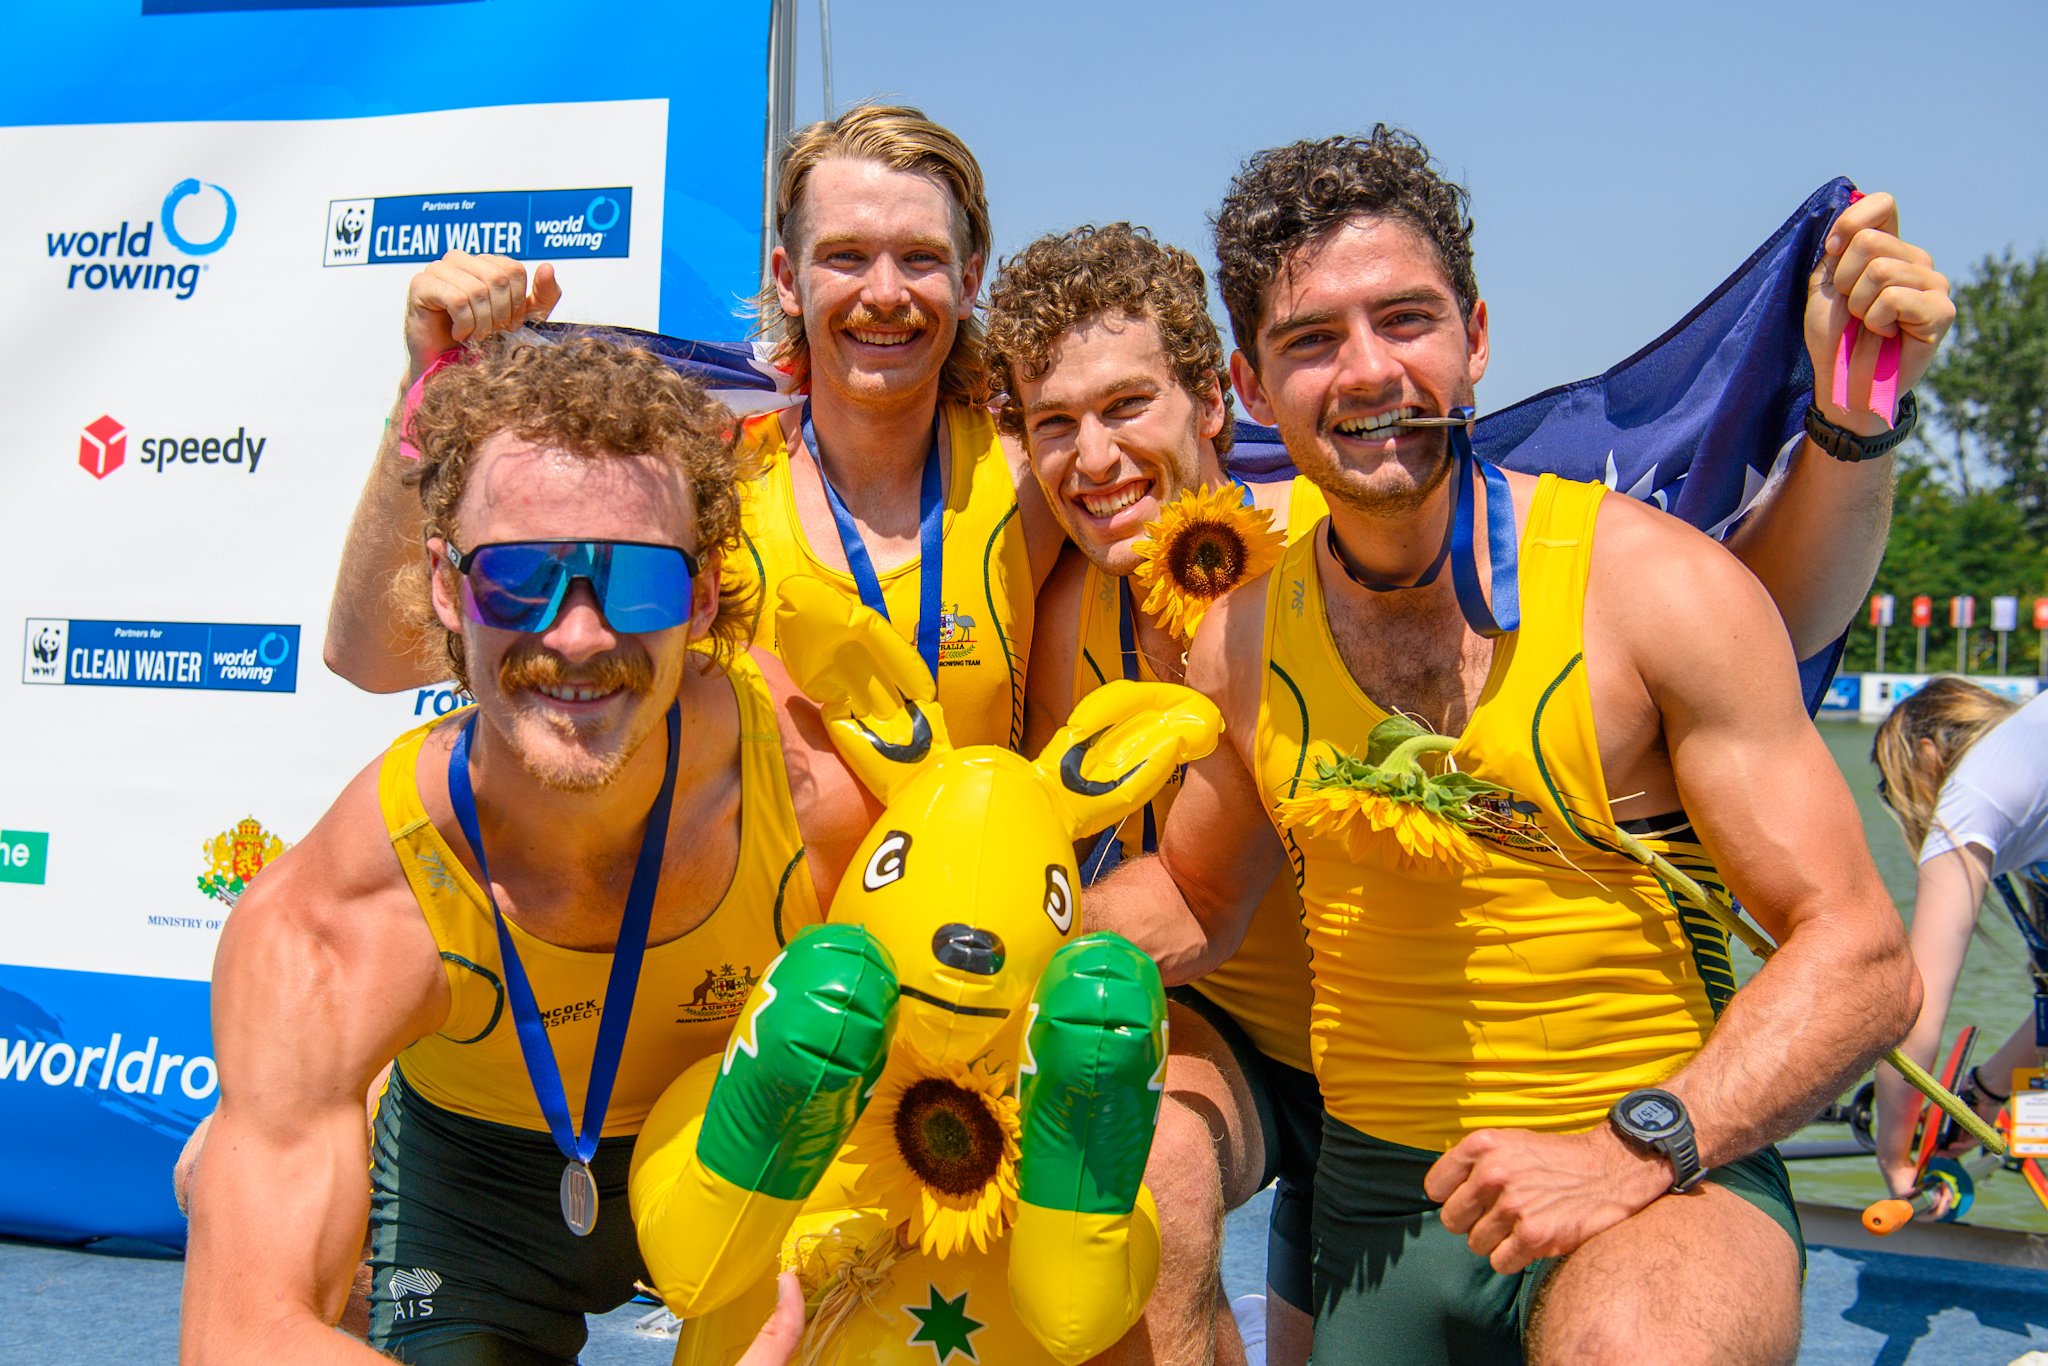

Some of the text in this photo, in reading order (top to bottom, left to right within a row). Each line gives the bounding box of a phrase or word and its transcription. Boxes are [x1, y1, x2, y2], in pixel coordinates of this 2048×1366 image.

[422, 200, 476, 212] Partners for
[535, 215, 585, 235] world
[47, 221, 154, 258] world
[374, 221, 523, 258] CLEAN WATER
[543, 231, 603, 251] rowing
[333, 247, 361, 258] WWF
[67, 262, 201, 301] rowing
[140, 426, 267, 473] speedy
[114, 627, 163, 639] Partners for
[939, 643, 965, 651] RALIA
[70, 647, 204, 683] CLEAN WATER
[213, 649, 259, 667] world
[32, 666, 57, 677] WWF
[220, 665, 275, 685] rowing
[414, 689, 477, 716] ro
[148, 915, 222, 930] MINISTRY OF
[0, 1033, 219, 1100] worldro
[394, 1298, 434, 1320] AIS
